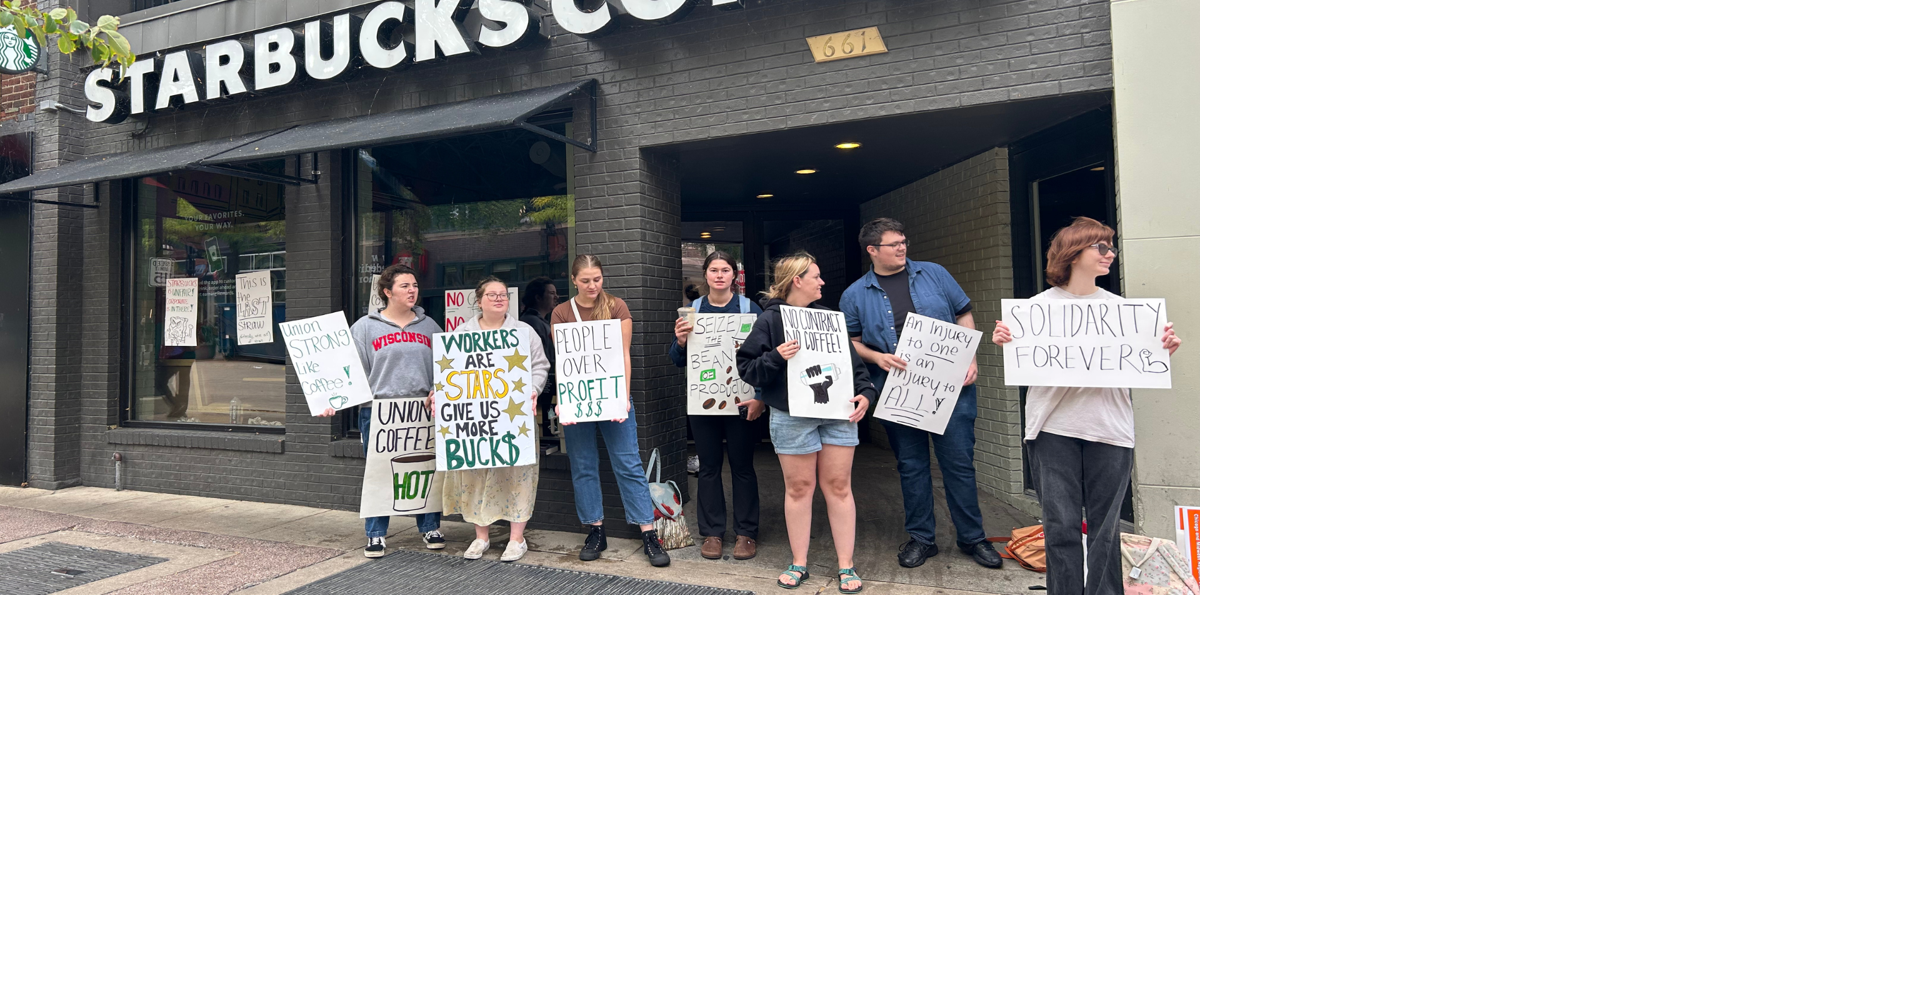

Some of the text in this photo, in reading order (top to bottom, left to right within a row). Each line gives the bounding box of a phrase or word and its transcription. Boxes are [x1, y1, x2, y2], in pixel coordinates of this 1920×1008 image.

[822, 31, 867, 58] 661
[85, 0, 532, 123] STARBUCKS
[185, 209, 245, 222] YOUR FAVORITES.
[215, 221, 234, 230] WAY.
[237, 276, 258, 290] This
[237, 292, 251, 303] the
[237, 296, 270, 317] LAST
[446, 291, 464, 308] NO
[281, 320, 322, 338] Union
[695, 315, 736, 335] SEIZE
[782, 307, 842, 333] NO CONTRACT
[905, 316, 923, 332] An
[1011, 302, 1161, 340] SOLIDARITY
[372, 331, 432, 351] WISCONSIN
[441, 328, 520, 354] WORKERS
[555, 323, 612, 355] PEOPLE
[705, 335, 723, 343] THE
[804, 331, 842, 354] COFFEE!
[906, 336, 959, 357] to one
[464, 352, 495, 369] ARE
[562, 353, 607, 378] OVER
[690, 349, 733, 370] BEAN
[900, 349, 935, 371] is an
[1015, 343, 1142, 374] FOREVER
[444, 368, 509, 401] STARS
[702, 371, 714, 380] OF
[558, 375, 624, 405] PROFIT
[690, 377, 753, 400] PRODUCTIO
[942, 382, 956, 393] to
[378, 400, 432, 426] UNION
[440, 400, 501, 422] GIVE US
[376, 425, 435, 454] COFFEE
[455, 419, 499, 439] MORE
[445, 430, 520, 471] BUCK$
[394, 470, 436, 501] HOT
